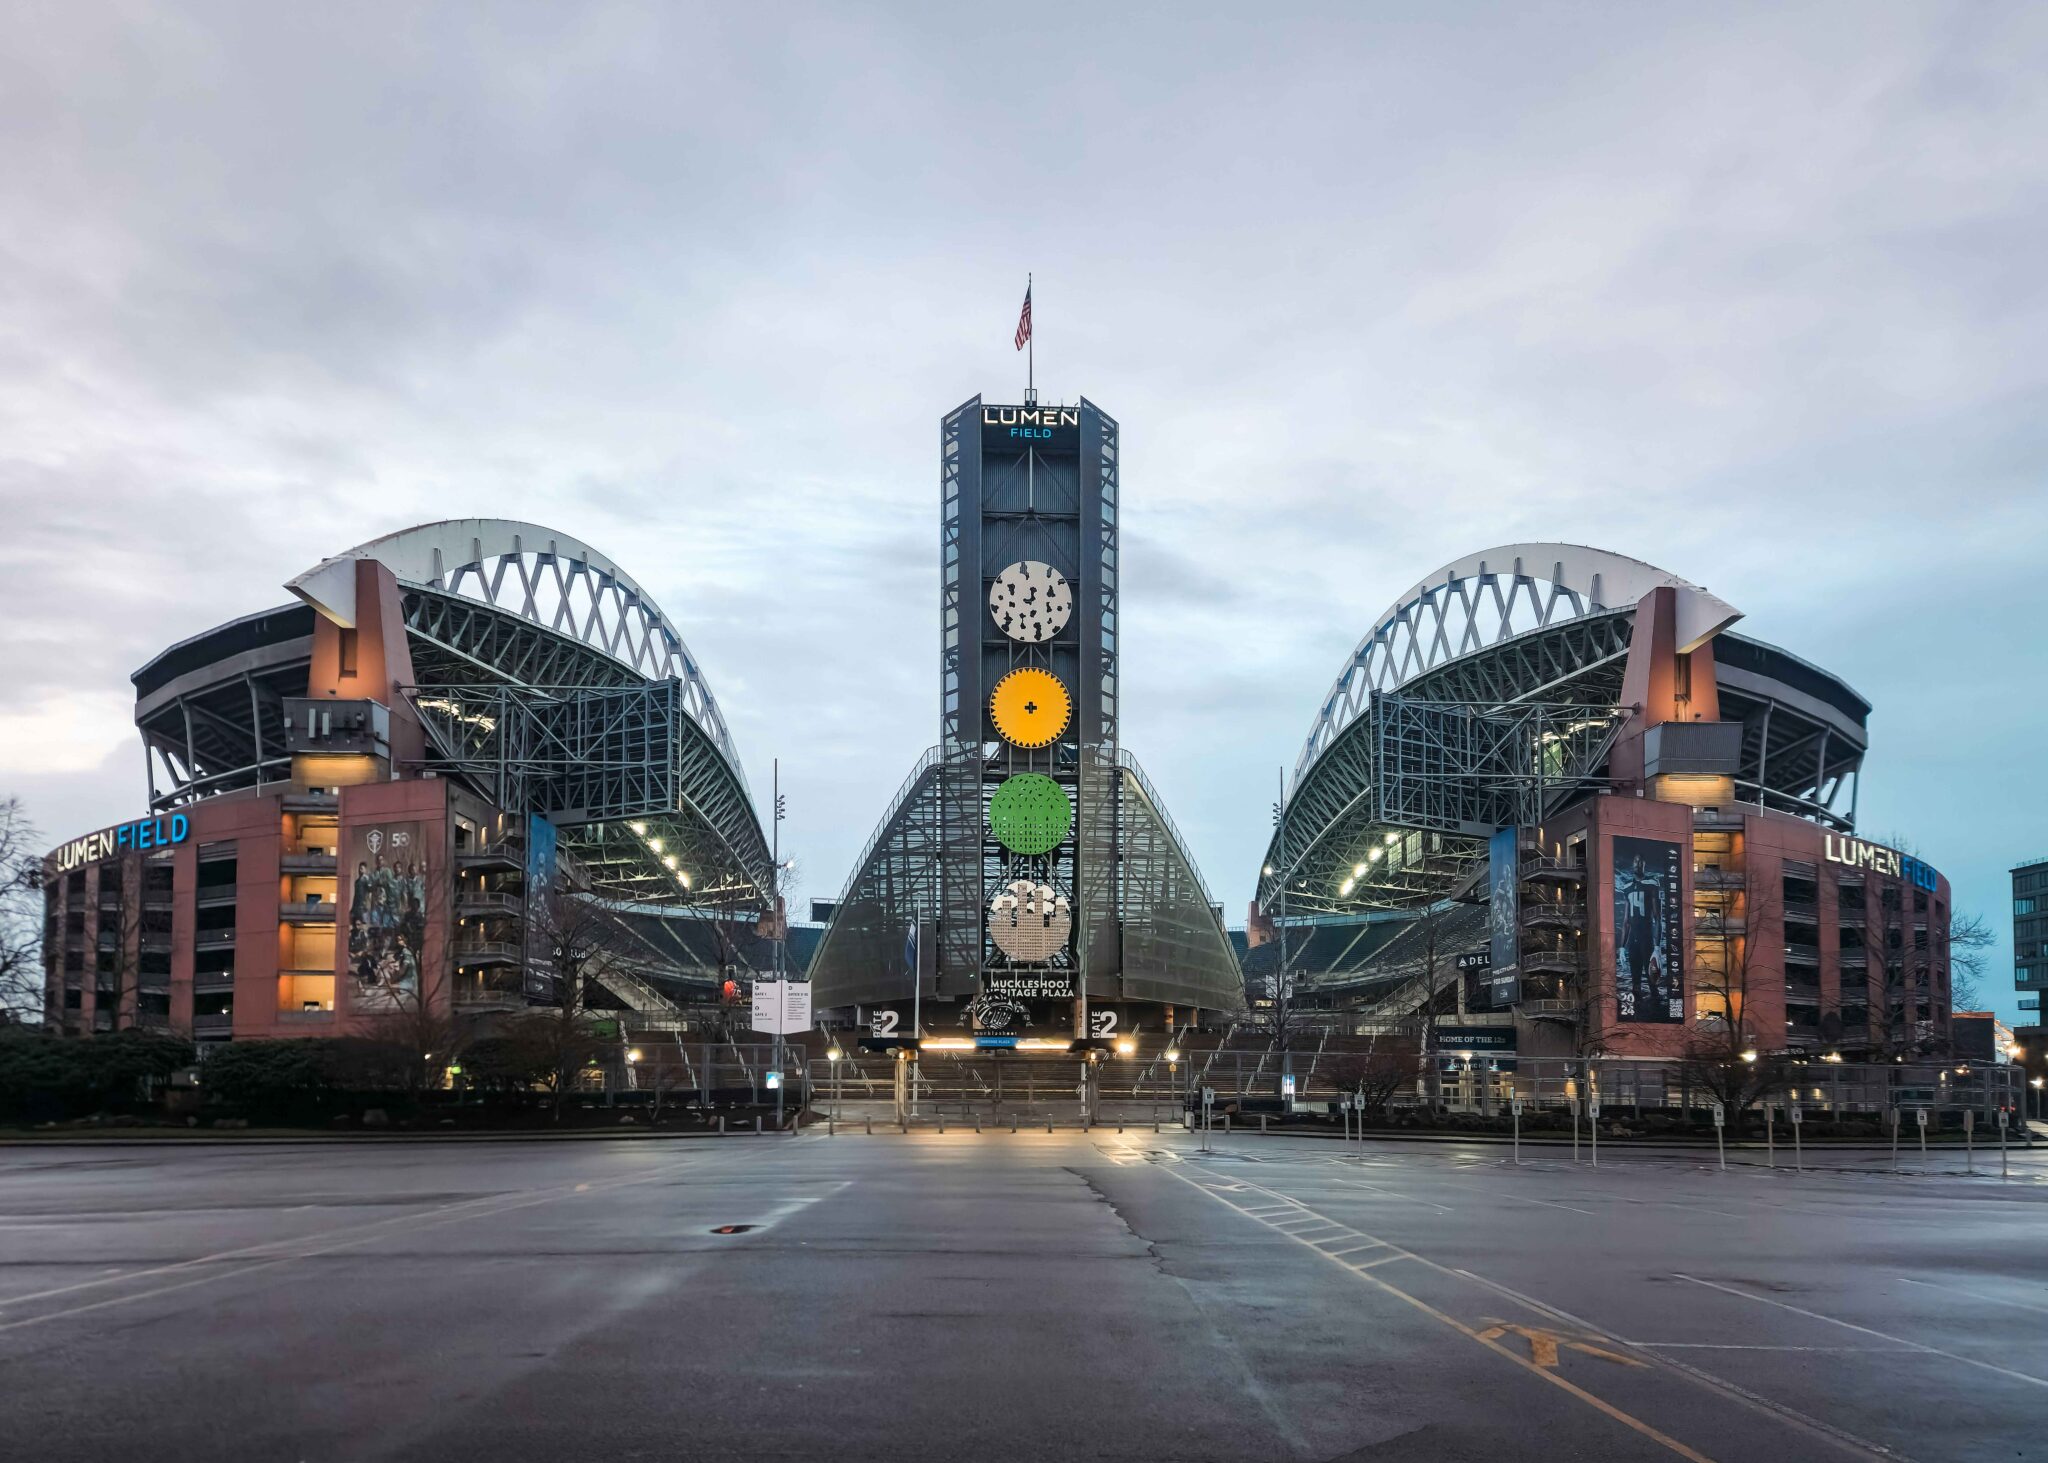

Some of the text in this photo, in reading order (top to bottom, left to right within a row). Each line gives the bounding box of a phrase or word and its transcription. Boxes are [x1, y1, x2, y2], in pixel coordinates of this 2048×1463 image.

[984, 409, 1078, 426] LUMEN
[1010, 428, 1052, 438] FIELD
[56, 814, 189, 872] LUMEN FIELD
[1825, 834, 1937, 892] LUMEN FIELD
[1469, 955, 1491, 966] DEL
[990, 980, 1071, 988] MUCKLESHOOT
[986, 989, 1075, 997] HRITAGE PLAZA
[1620, 992, 1635, 1003] 20
[1620, 1005, 1635, 1016] 24
[872, 1010, 899, 1039] GATE 2
[1091, 1011, 1118, 1039] GATE 2
